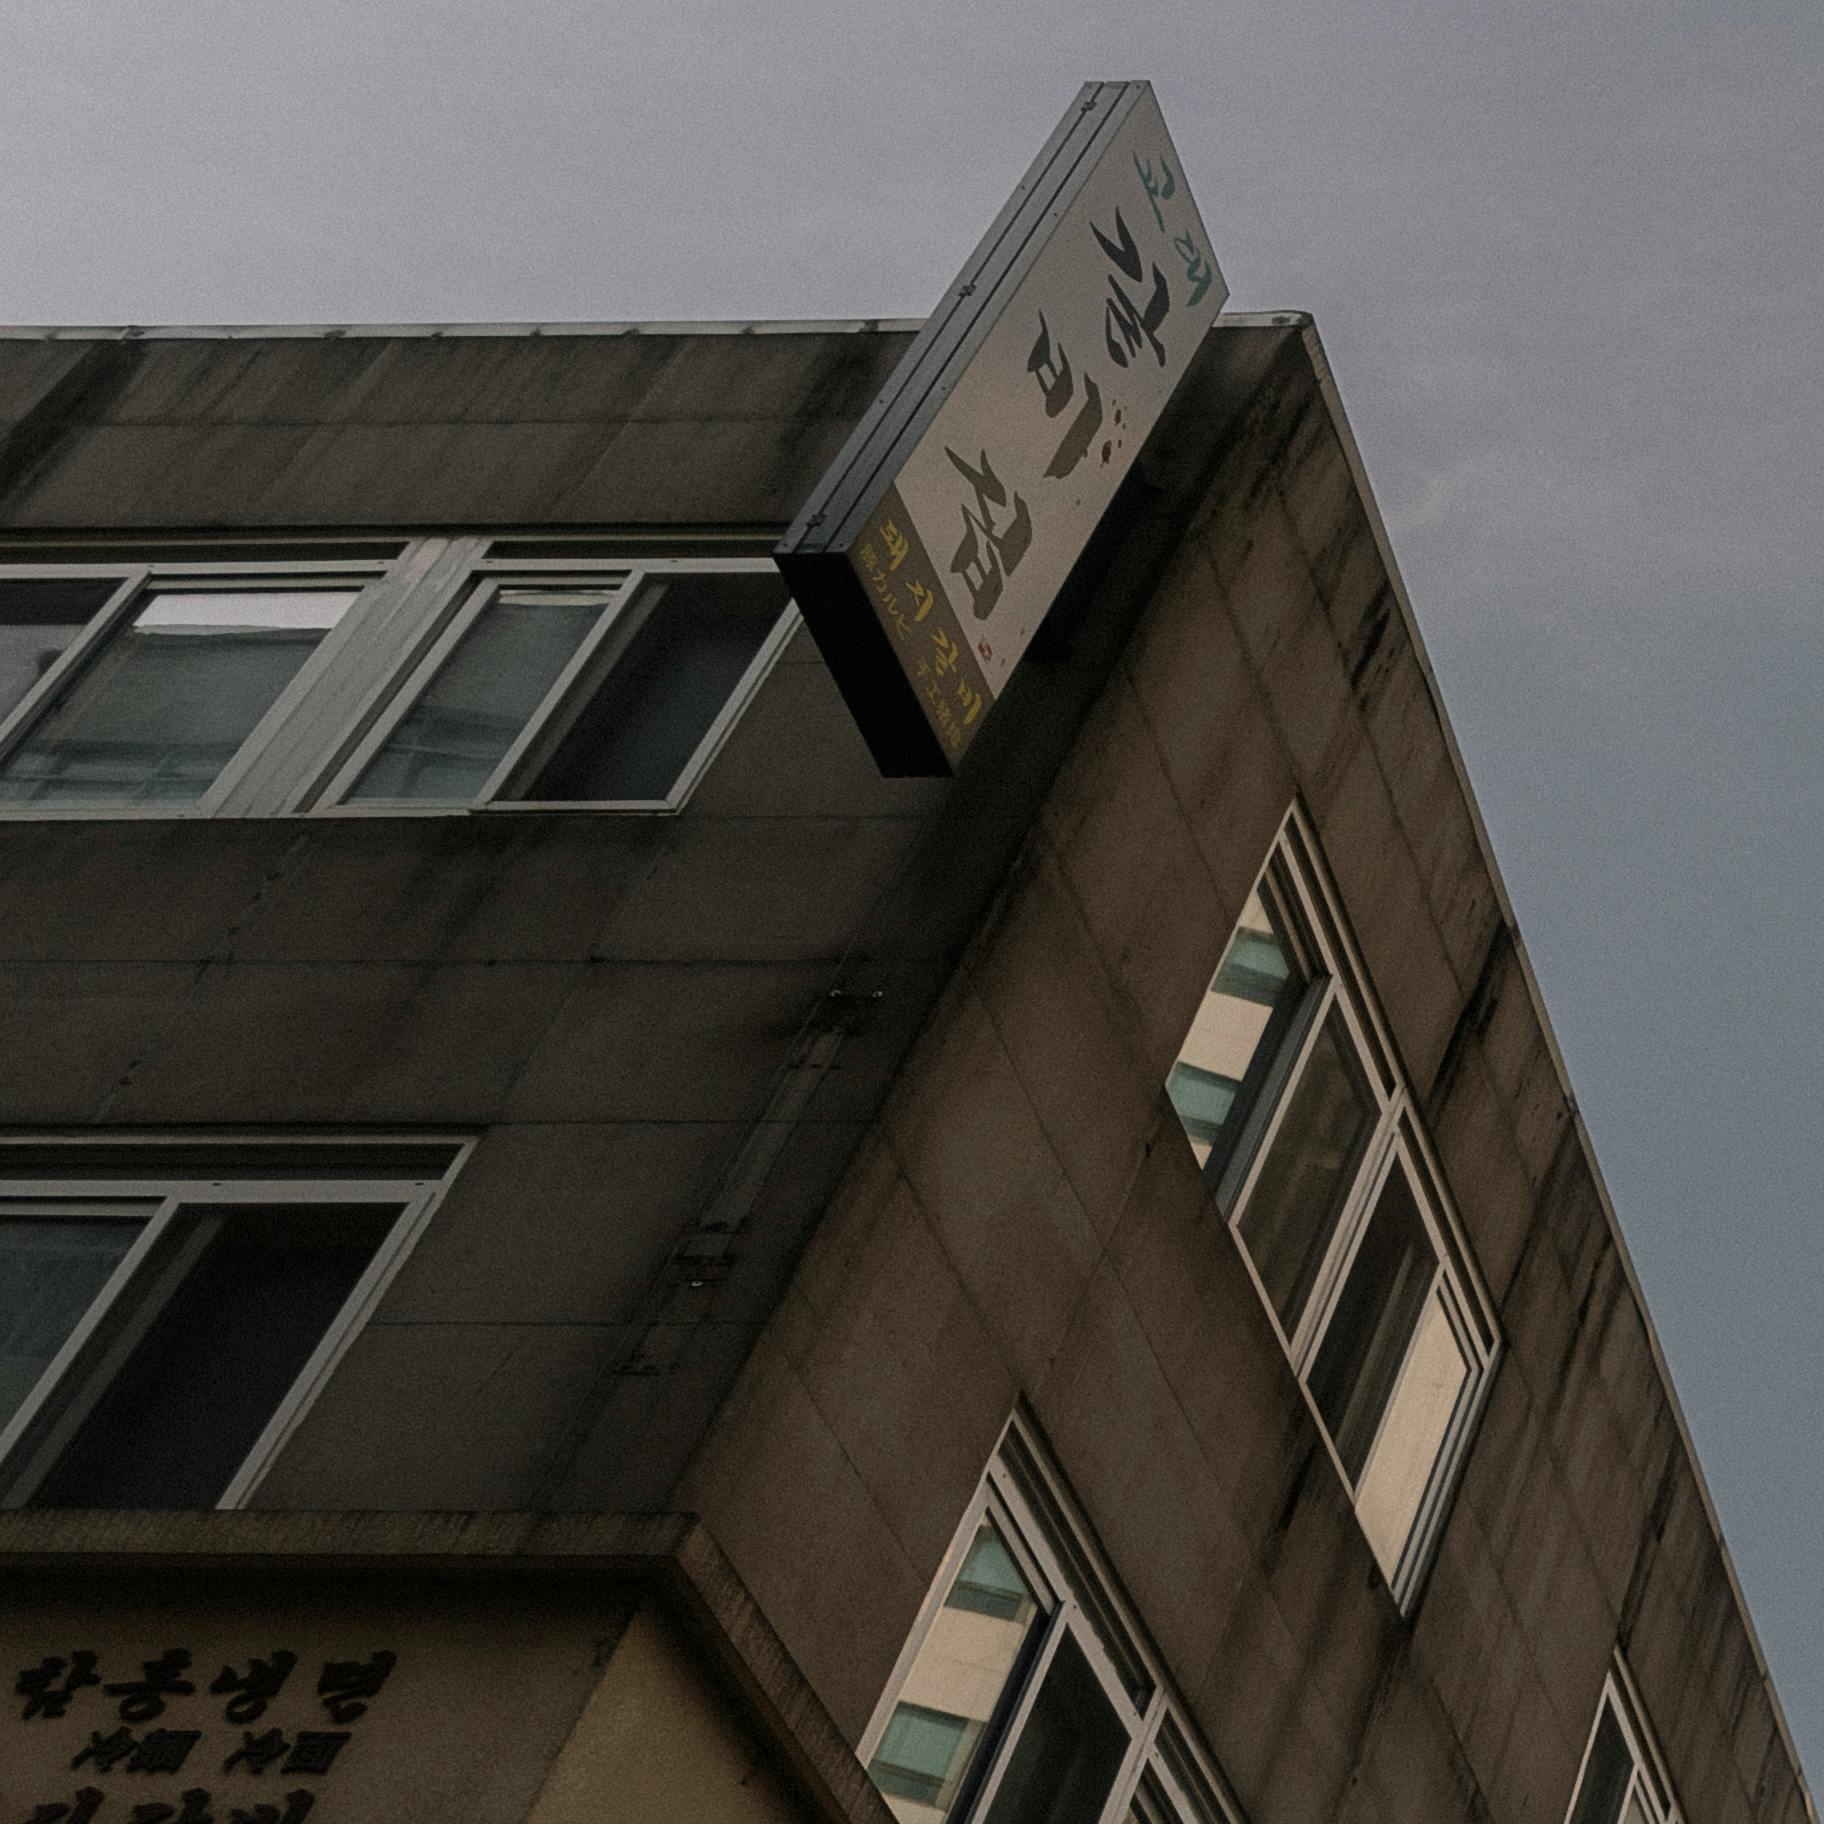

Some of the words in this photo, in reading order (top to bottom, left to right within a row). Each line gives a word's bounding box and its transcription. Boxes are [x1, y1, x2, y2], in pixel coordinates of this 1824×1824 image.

[1132, 151, 1213, 308] 교대
[949, 206, 1170, 621] 갈비집
[878, 518, 982, 725] 돼지갈비
[15, 1647, 397, 1724] 함흥냉면
